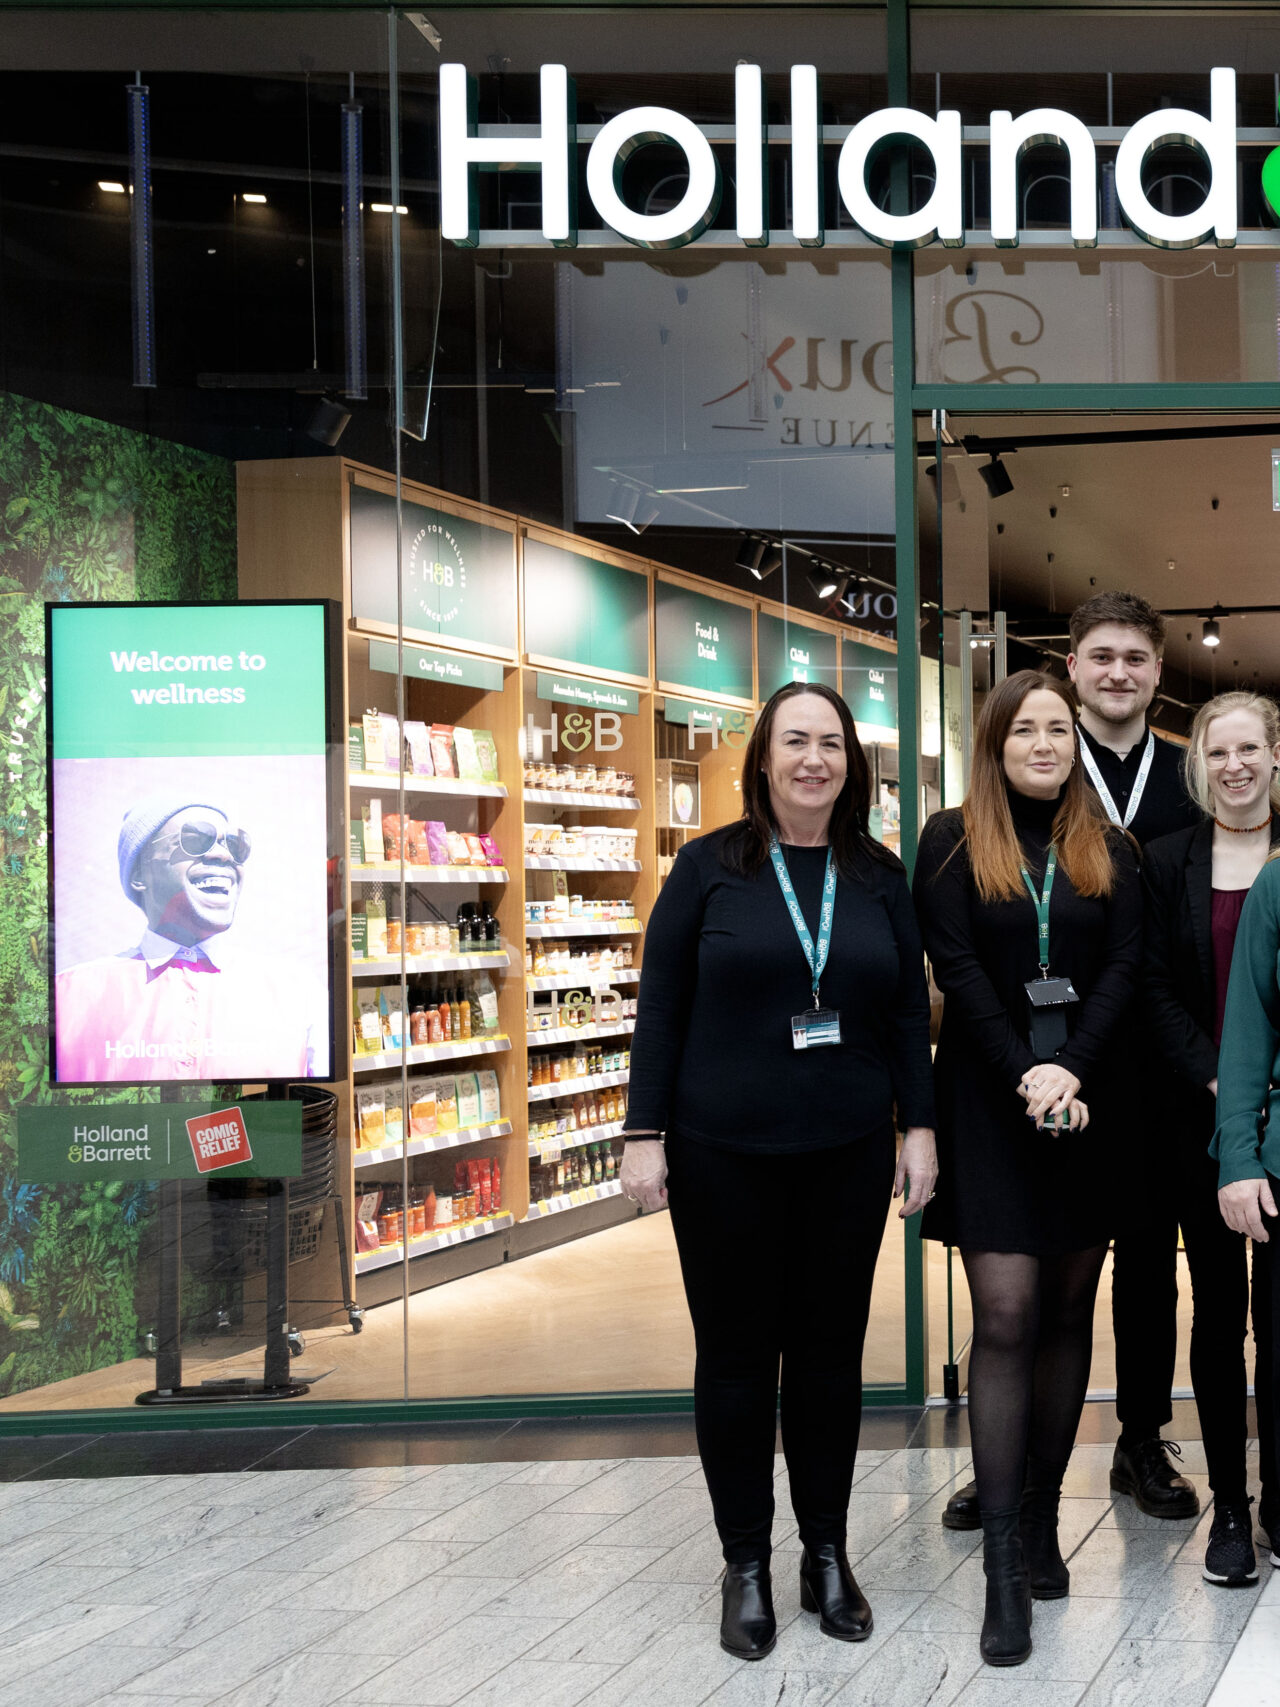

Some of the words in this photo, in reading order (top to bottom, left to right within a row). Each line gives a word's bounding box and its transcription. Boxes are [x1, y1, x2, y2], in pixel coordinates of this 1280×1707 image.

[422, 559, 455, 587] H&B
[695, 621, 712, 638] Food
[110, 651, 233, 673] Welcome
[238, 651, 267, 672] to
[697, 643, 718, 662] Drink
[419, 657, 433, 672] Our
[433, 660, 446, 678] Top
[131, 683, 246, 705] wellness
[527, 712, 624, 753] H&B
[688, 711, 759, 750] H&
[527, 989, 624, 1030] H&B
[74, 1124, 149, 1143] Holland
[195, 1121, 240, 1145] COMIC
[67, 1143, 152, 1163] &Barrett
[199, 1135, 242, 1159] RELIEF
